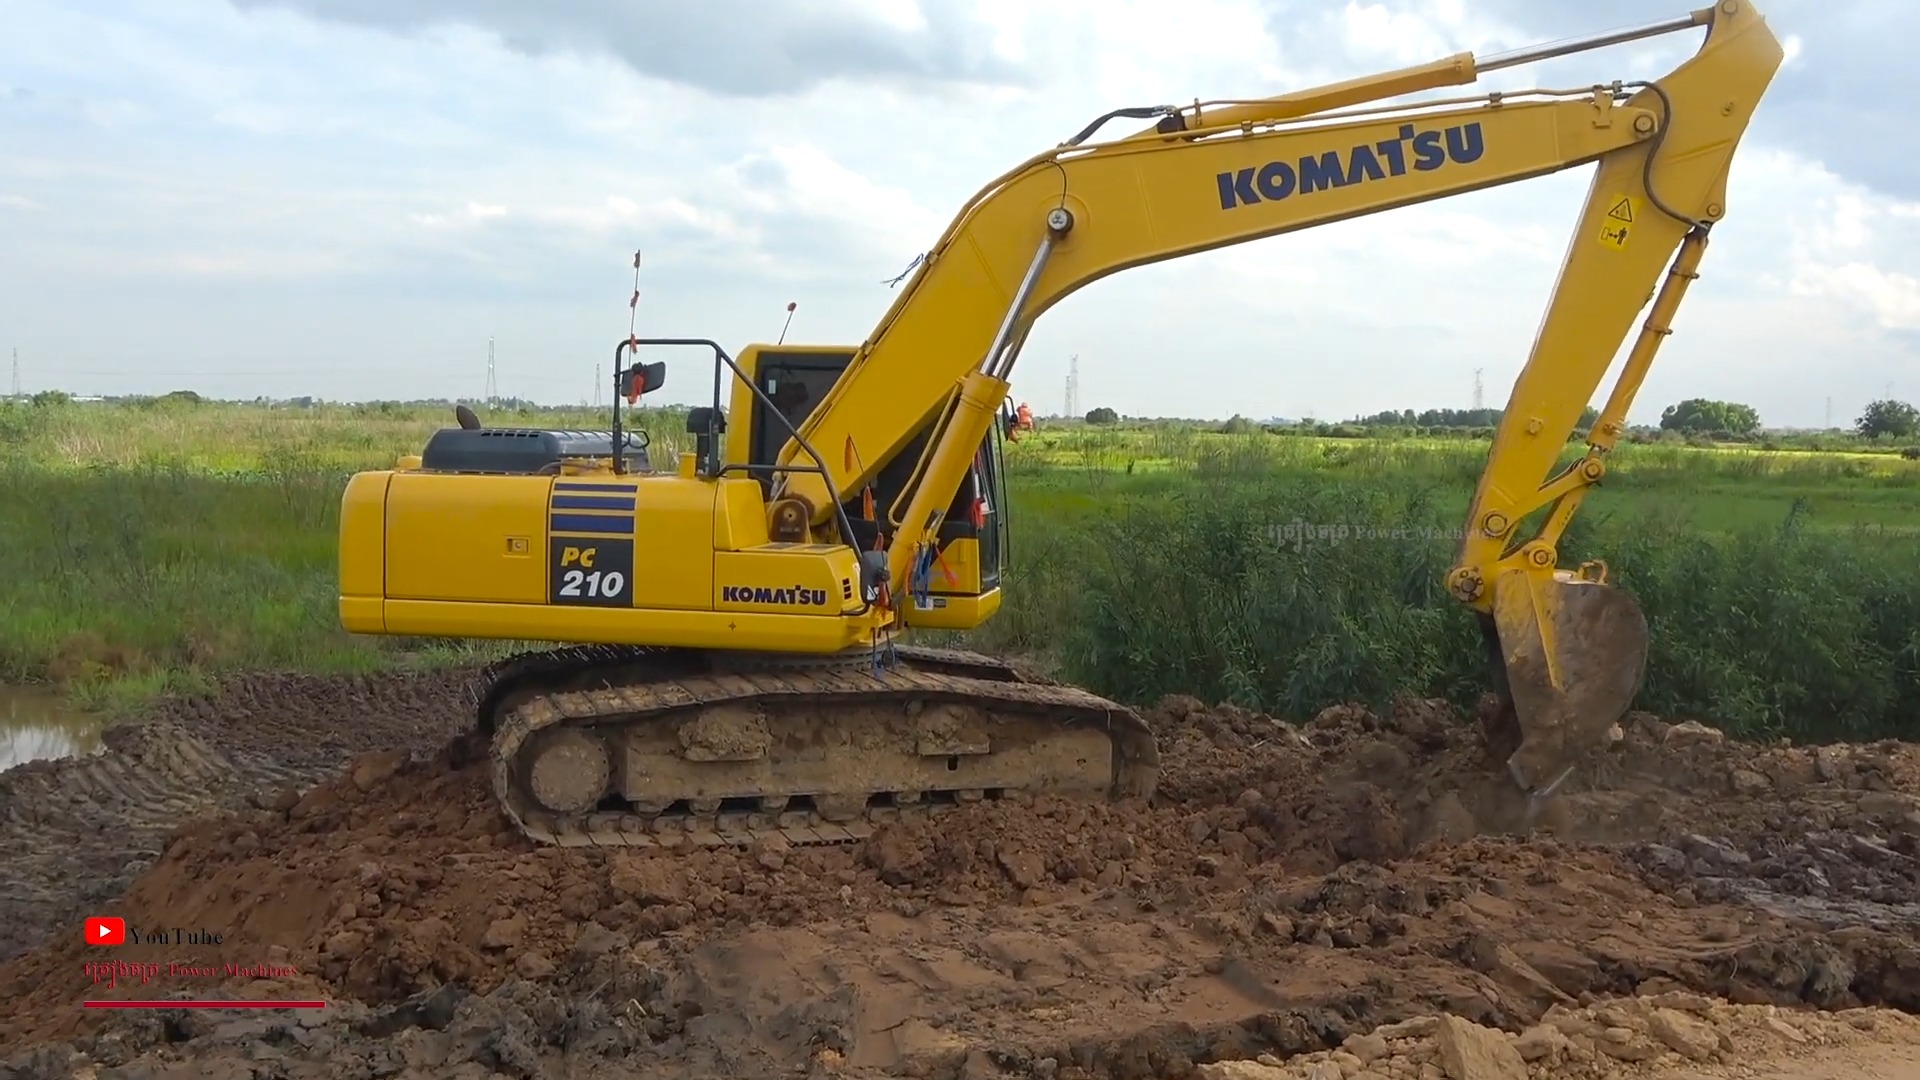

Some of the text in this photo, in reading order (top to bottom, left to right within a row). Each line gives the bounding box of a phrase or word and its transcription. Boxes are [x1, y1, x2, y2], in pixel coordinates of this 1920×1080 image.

[1217, 122, 1484, 210] KOMATSU
[561, 546, 596, 568] PC
[559, 570, 624, 598] 210
[722, 585, 826, 605] KOMATSU
